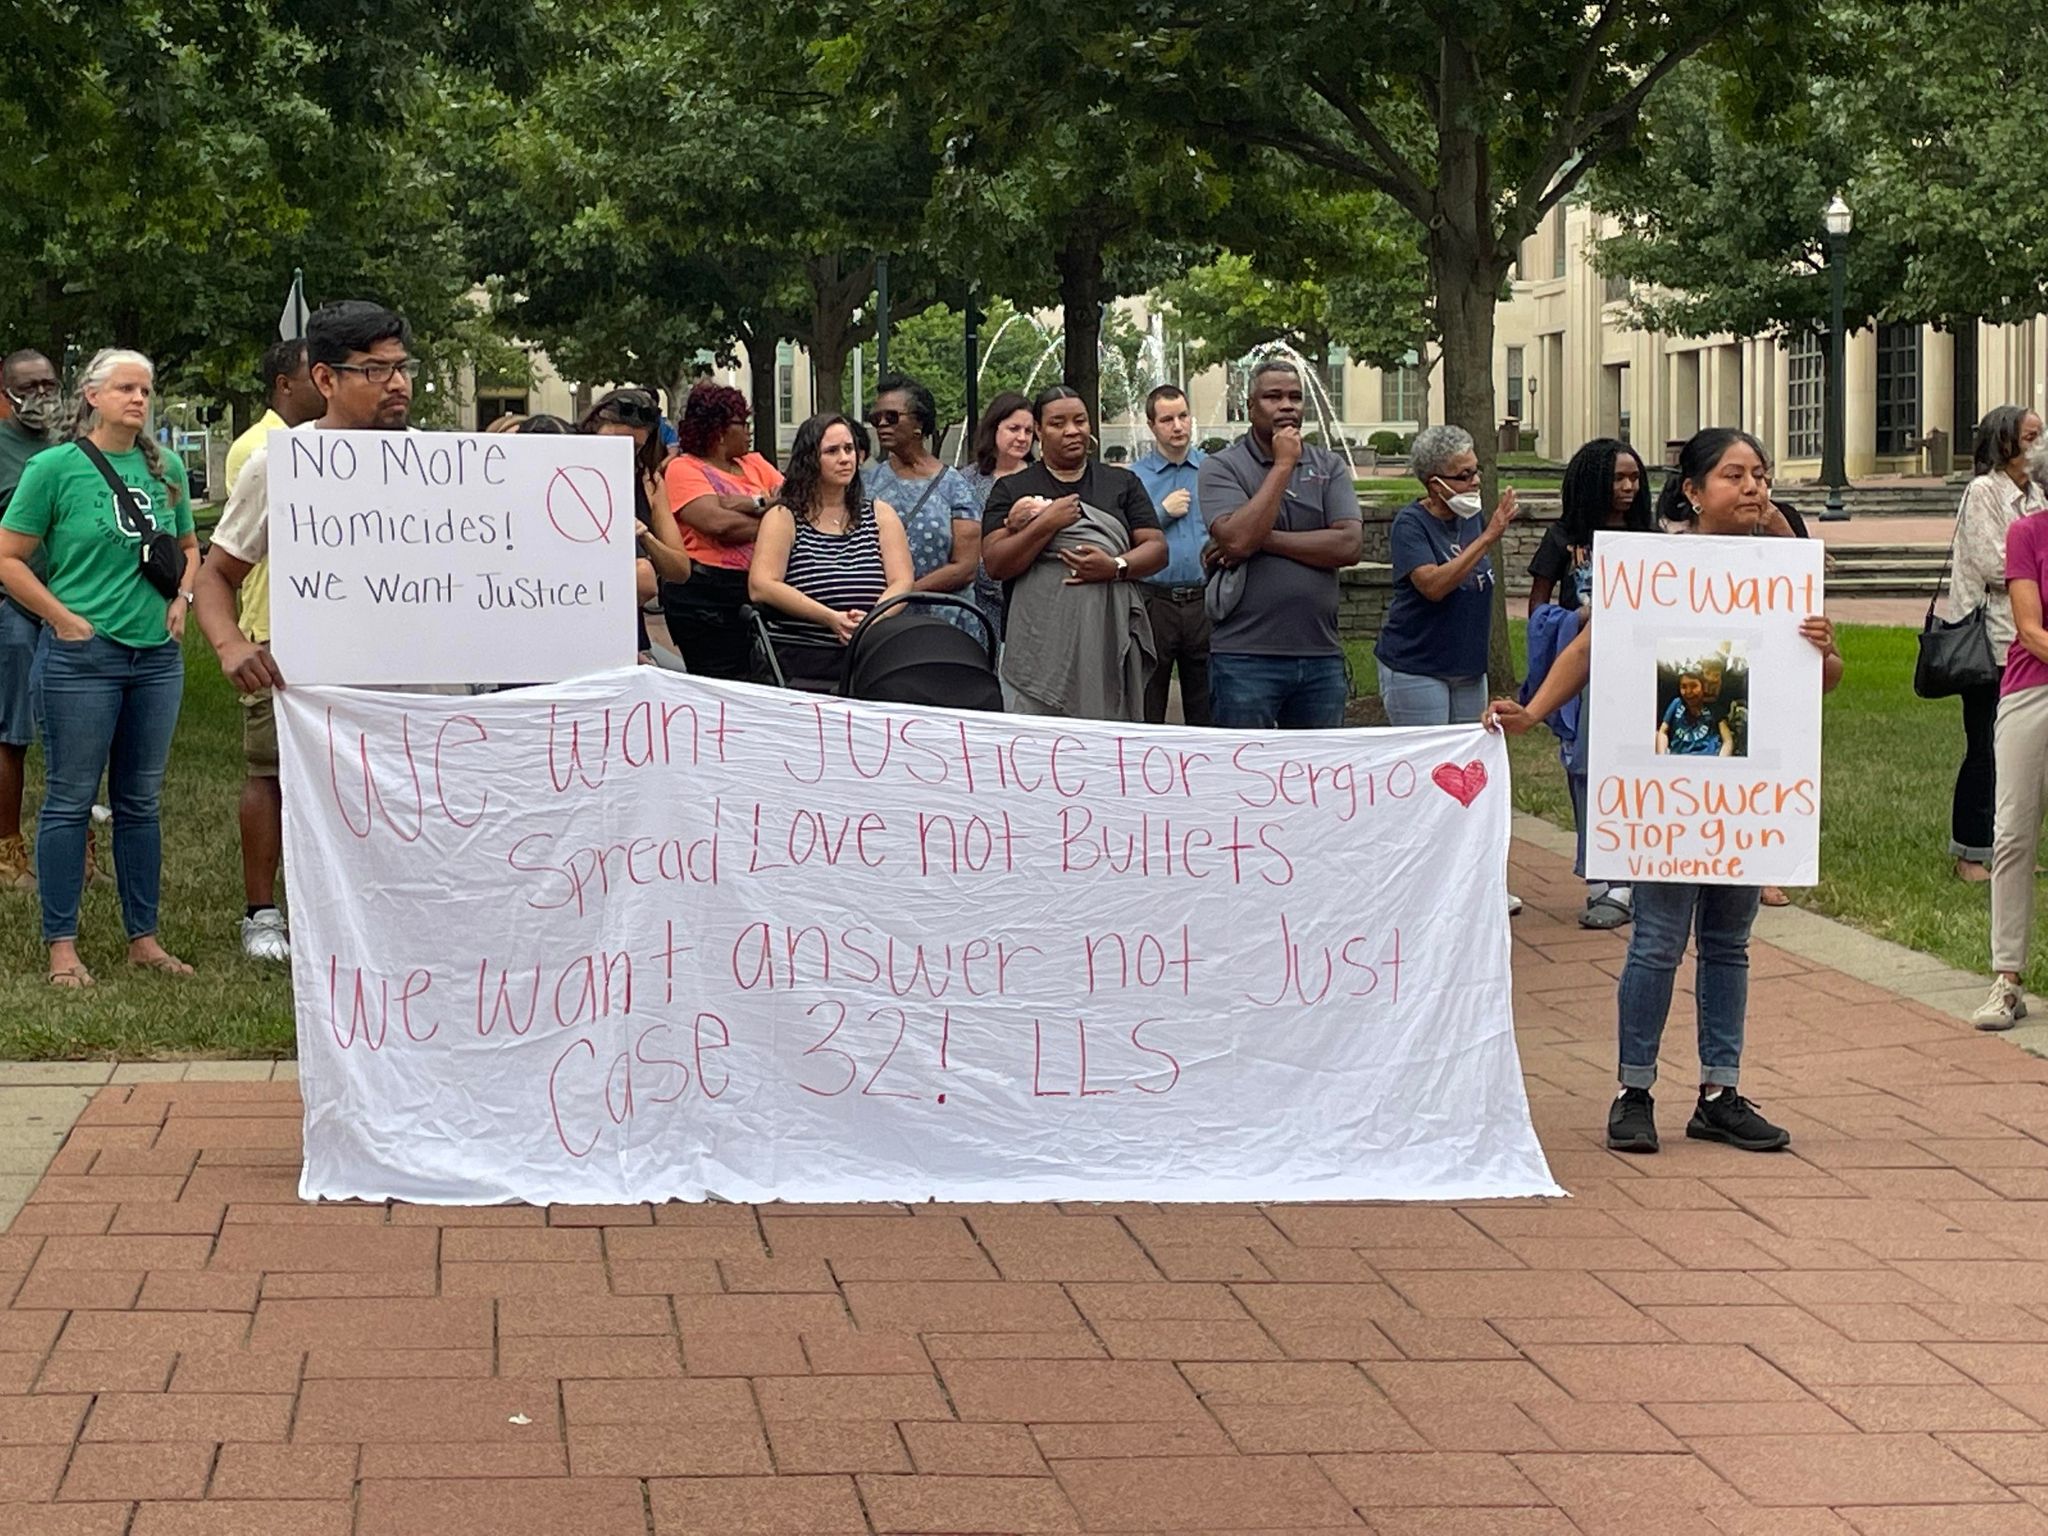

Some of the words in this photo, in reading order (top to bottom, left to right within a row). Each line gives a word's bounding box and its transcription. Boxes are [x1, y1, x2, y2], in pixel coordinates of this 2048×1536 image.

[381, 437, 506, 487] More
[289, 503, 514, 551] Homicides!
[1600, 554, 1678, 610] We
[1233, 742, 1416, 822] Sergio
[1597, 776, 1816, 819] answers
[749, 803, 887, 871] Love
[918, 810, 1031, 877] not
[1057, 805, 1295, 886] Bullets
[1699, 819, 1786, 857] gun
[732, 921, 1046, 998] answer
[1085, 924, 1206, 996] not
[549, 1012, 731, 1158] Case
[799, 1000, 947, 1105] 32!
[1034, 1017, 1181, 1098] LLS
